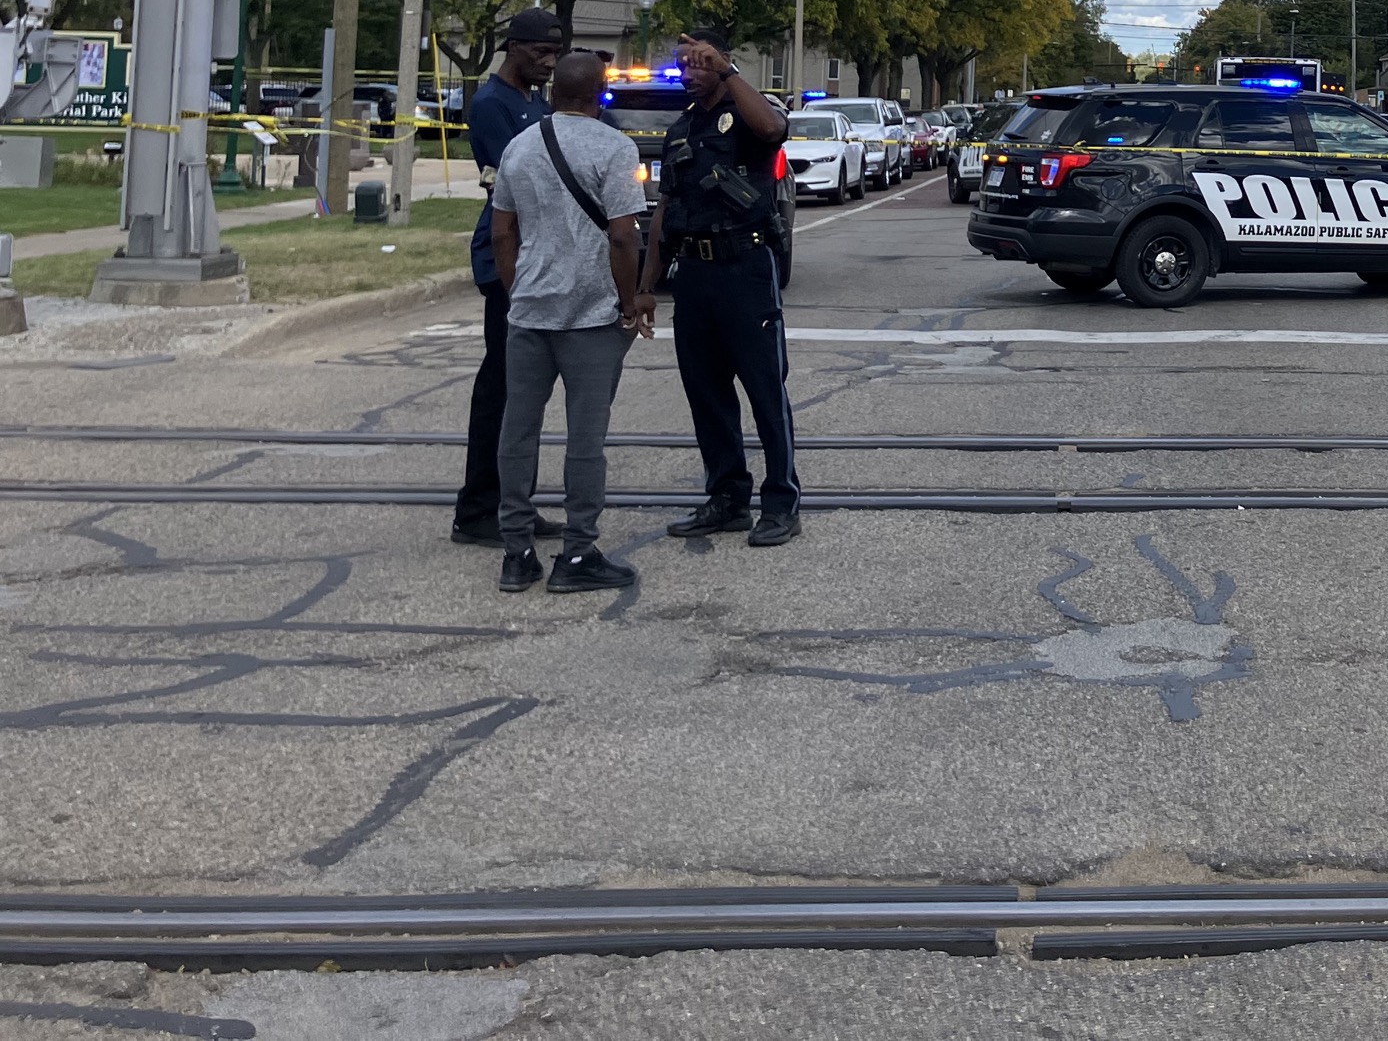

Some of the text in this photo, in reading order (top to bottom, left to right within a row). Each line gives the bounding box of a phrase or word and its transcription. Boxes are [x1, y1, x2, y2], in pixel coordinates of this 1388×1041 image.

[112, 91, 128, 104] Ki
[92, 105, 122, 118] Park
[1022, 165, 1035, 173] FIRE
[1238, 224, 1315, 237] KALAMAZOO
[1319, 225, 1362, 239] PUBLIC
